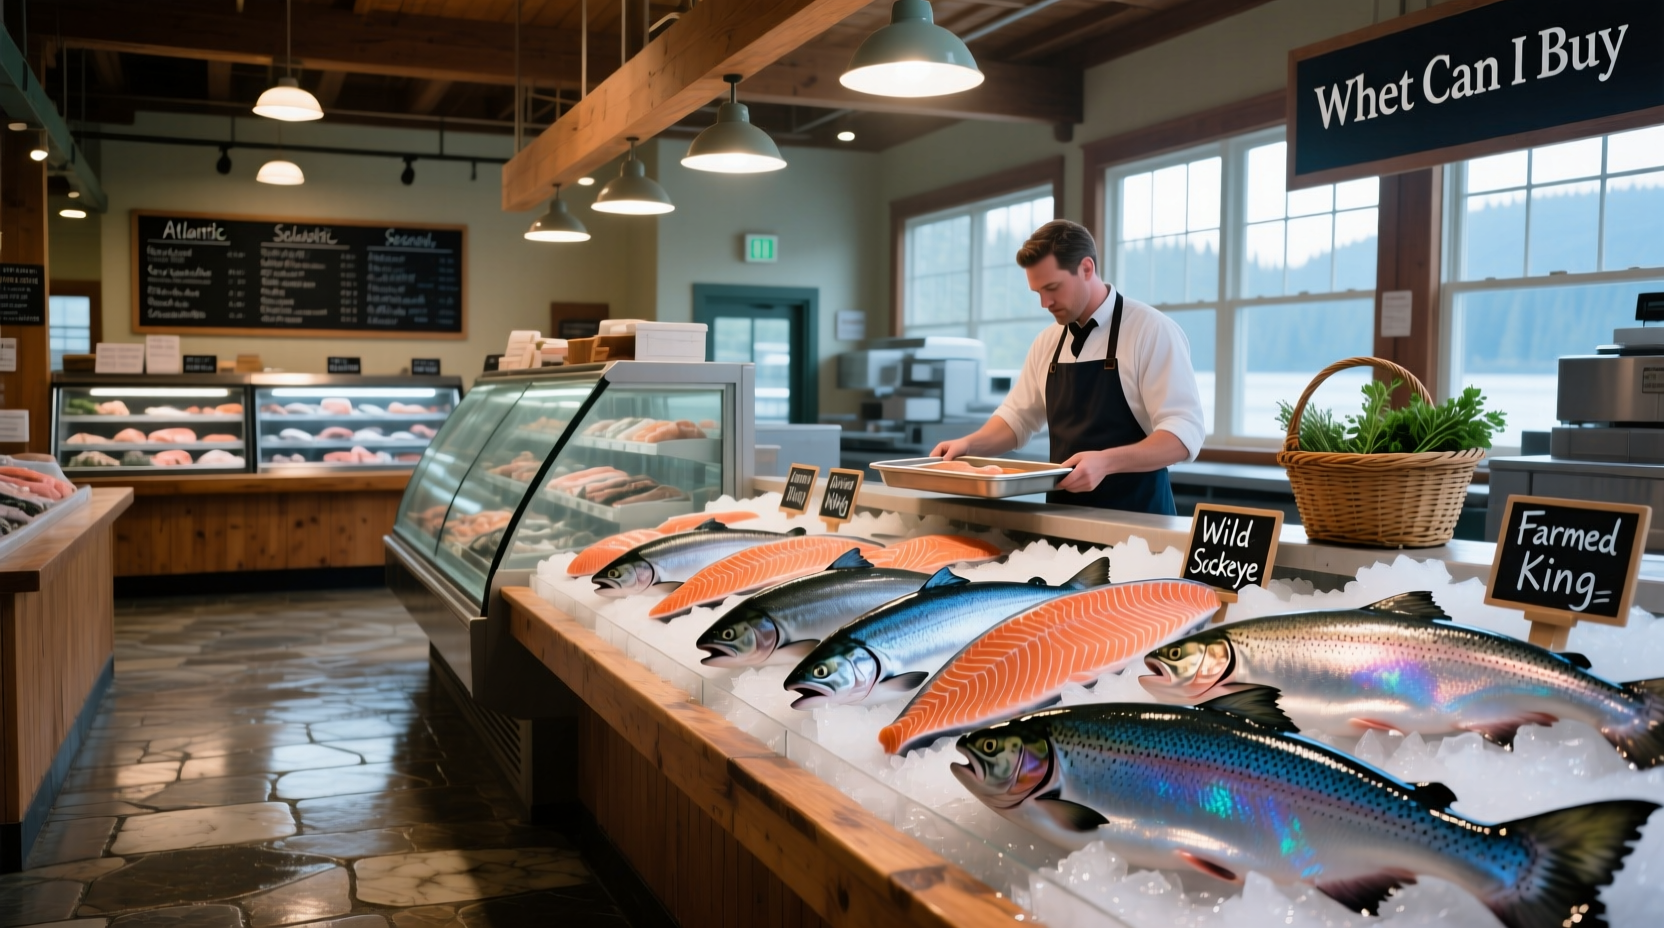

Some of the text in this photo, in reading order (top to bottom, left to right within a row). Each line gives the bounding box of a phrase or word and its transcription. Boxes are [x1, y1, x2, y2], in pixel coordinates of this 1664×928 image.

[1314, 24, 1629, 130] Whet Can I Buy
[1203, 515, 1254, 548] Wild
[1516, 510, 1622, 556] Farmed
